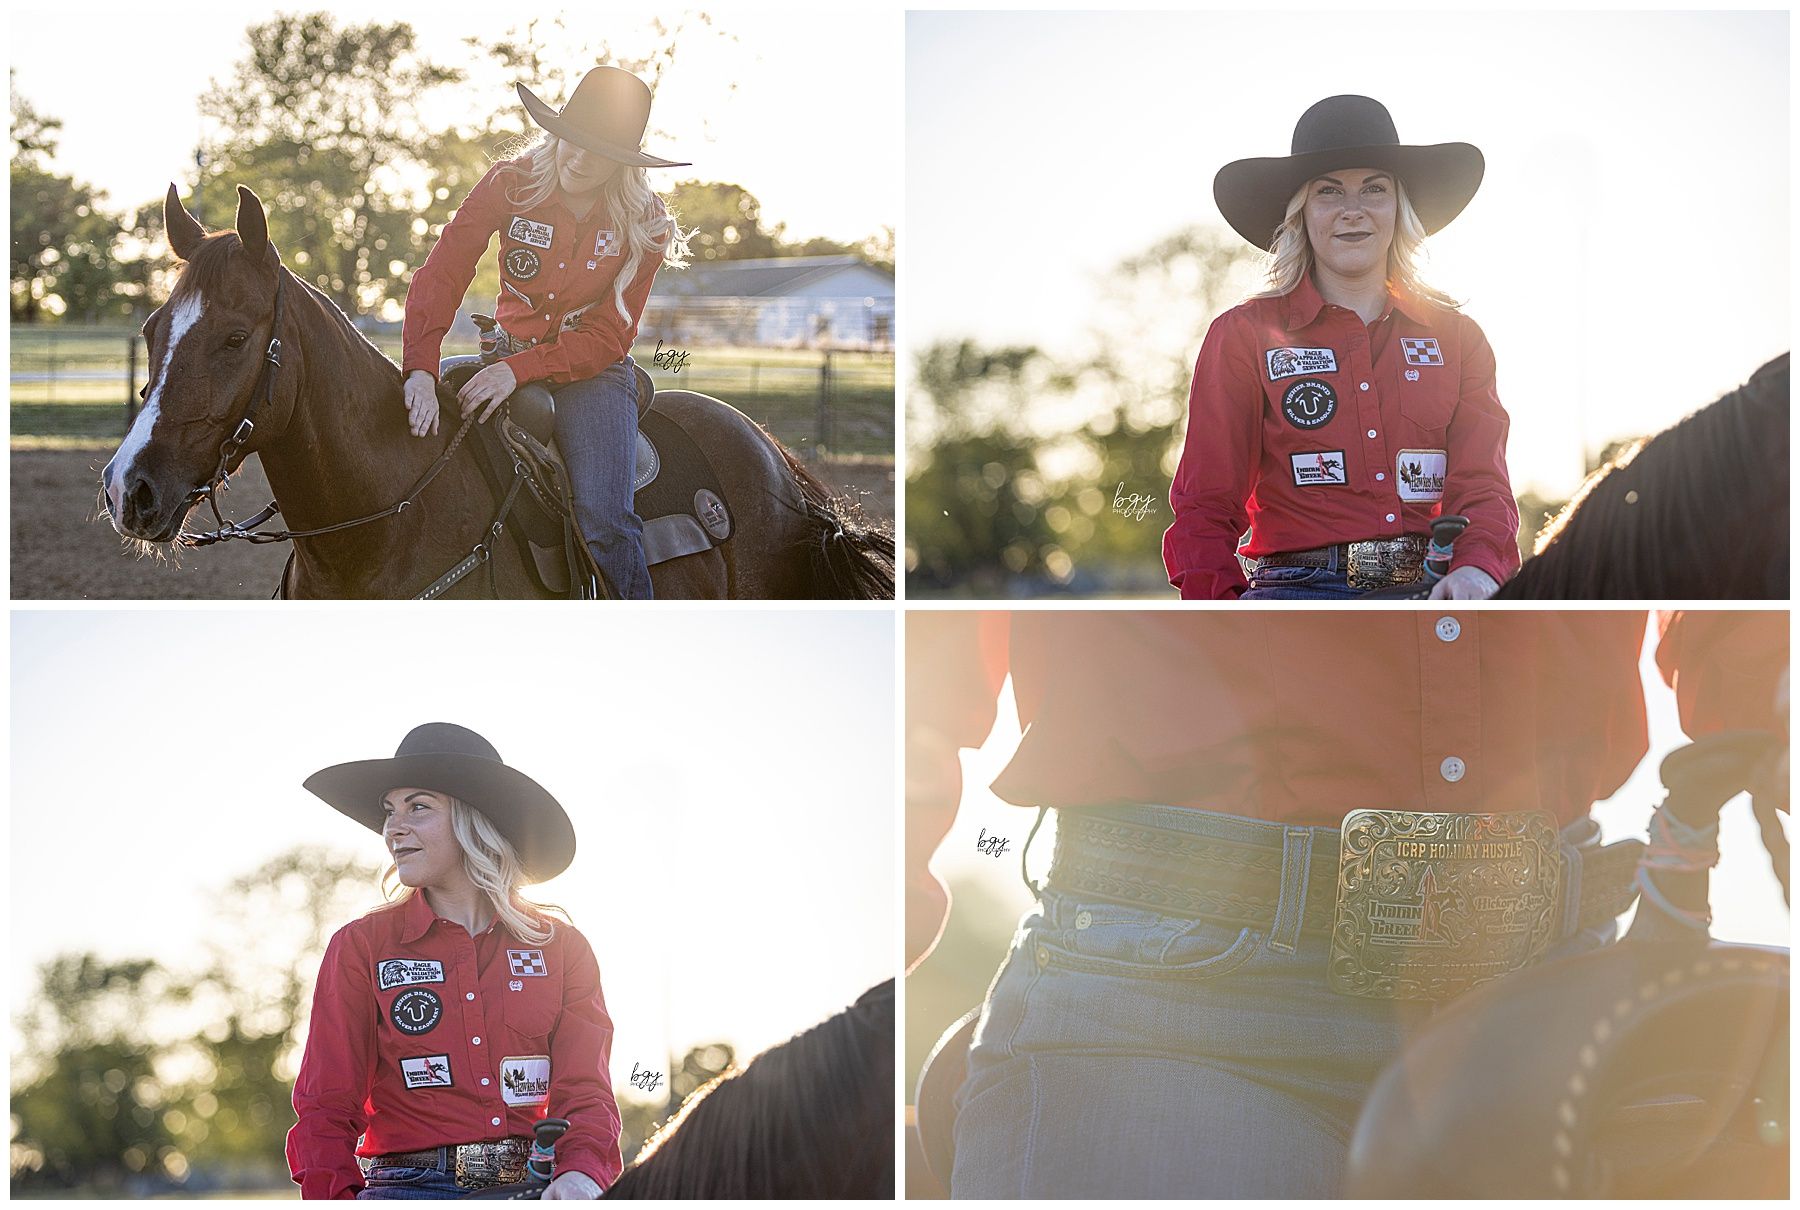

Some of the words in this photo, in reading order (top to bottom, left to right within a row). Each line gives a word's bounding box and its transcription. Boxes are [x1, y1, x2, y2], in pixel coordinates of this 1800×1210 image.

[1306, 382, 1331, 396] BRAND
[1446, 815, 1483, 840] 2022
[1397, 842, 1426, 857] ICRP
[1430, 843, 1480, 859] HOLIDAY
[1481, 841, 1522, 859] HUSTLE
[1369, 901, 1423, 920] INDIAN
[1372, 921, 1420, 936] CREEK
[515, 1078, 535, 1092] Hawkes
[536, 1077, 548, 1091] Nest
